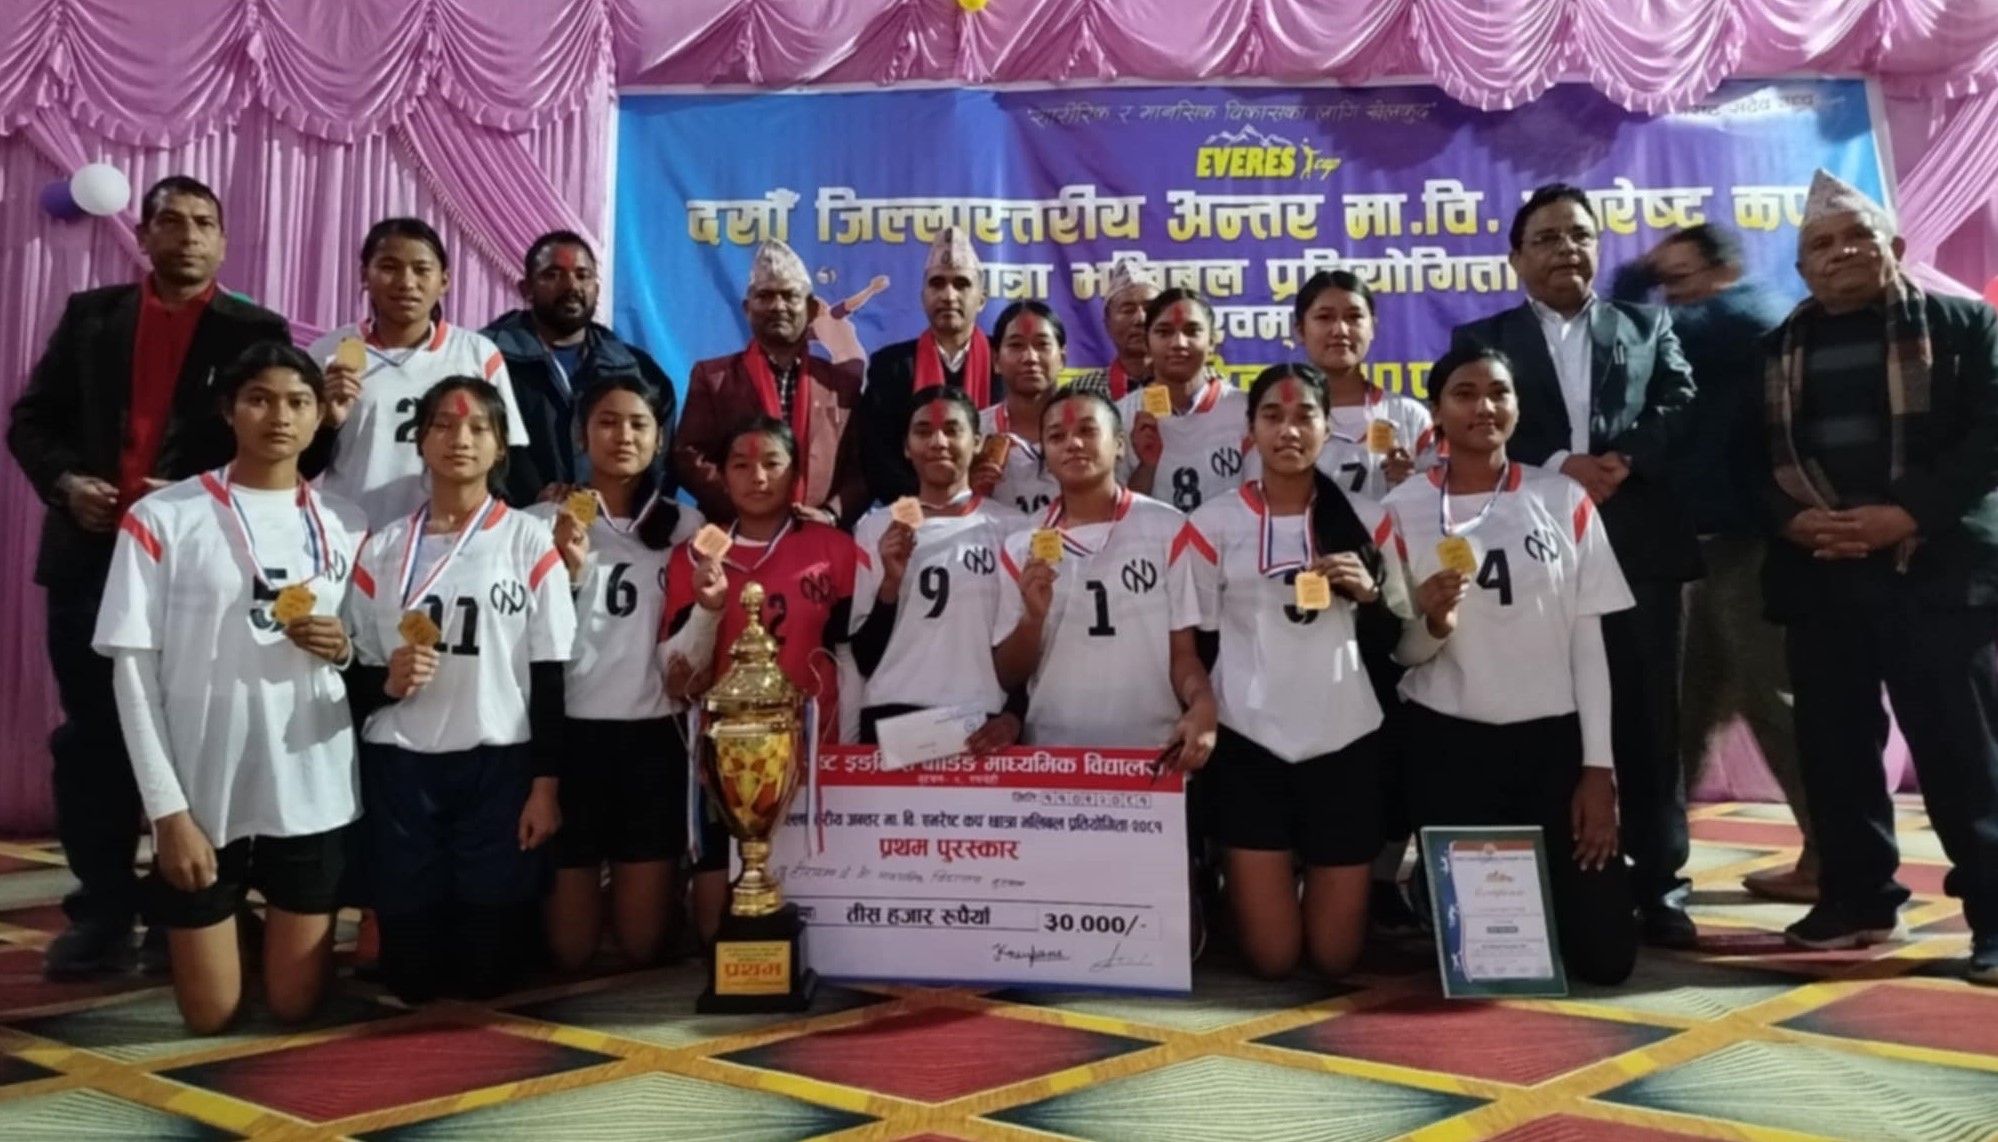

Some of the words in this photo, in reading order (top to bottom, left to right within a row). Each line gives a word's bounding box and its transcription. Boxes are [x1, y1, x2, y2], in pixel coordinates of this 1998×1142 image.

[1166, 190, 1325, 242] अन्तर
[1172, 467, 1201, 512] 8
[1341, 462, 1368, 492] 7
[606, 562, 636, 617] 6
[919, 566, 950, 618] 9
[1476, 548, 1513, 606] 4
[1085, 580, 1116, 636] 1
[984, 751, 1078, 774] माध्यमिक
[878, 838, 929, 859] प्रथम
[936, 838, 1022, 863] पुरस्कार
[846, 902, 881, 924] तीस
[886, 907, 936, 927] हजार
